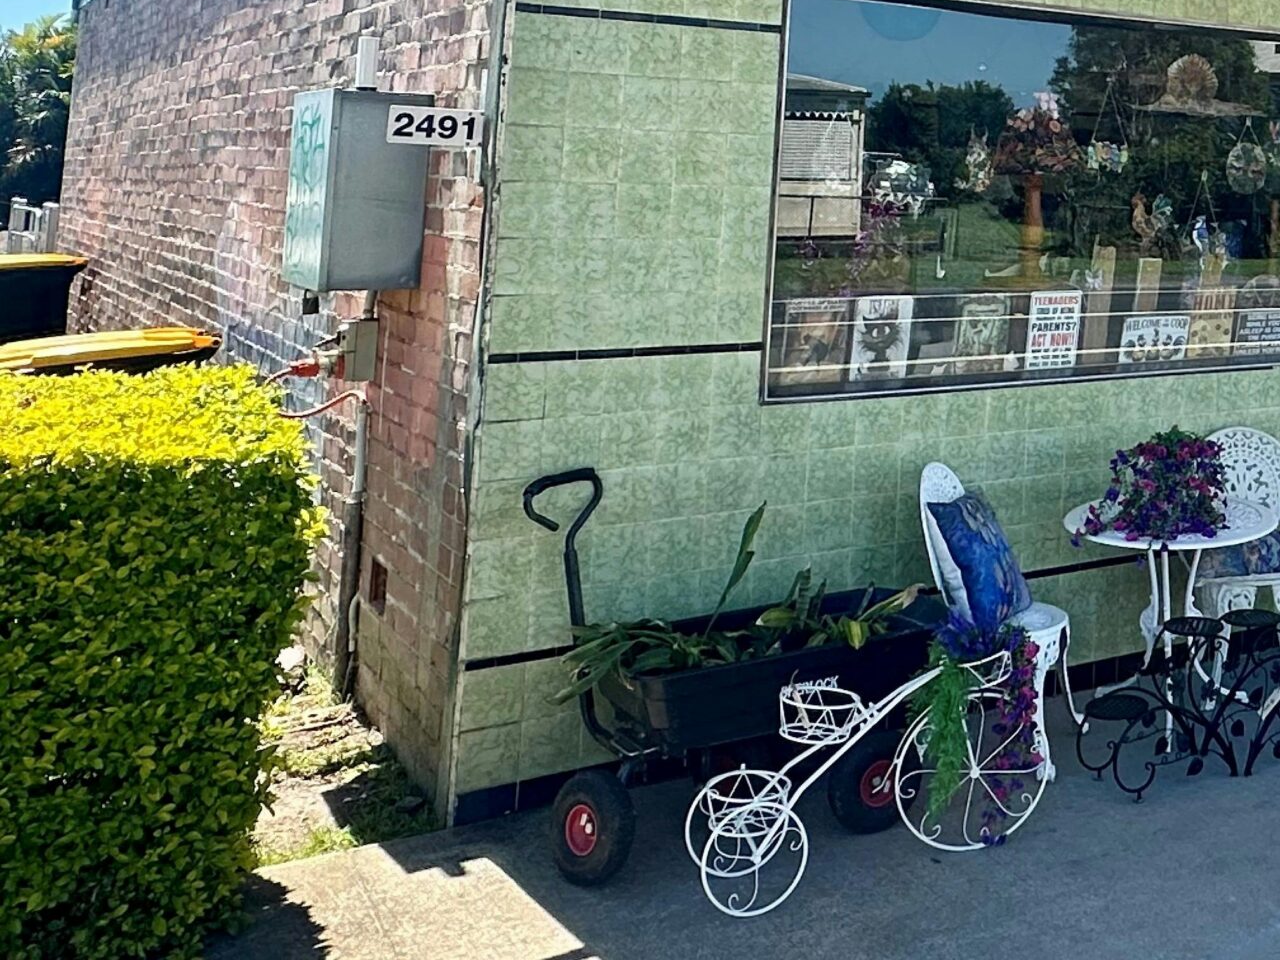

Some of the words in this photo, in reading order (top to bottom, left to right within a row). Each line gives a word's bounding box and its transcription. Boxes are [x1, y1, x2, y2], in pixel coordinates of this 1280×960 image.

[392, 112, 477, 140] 2491
[1031, 321, 1077, 333] PARENTS?
[1125, 319, 1160, 332] WELCOME
[1031, 333, 1047, 347] ACT
